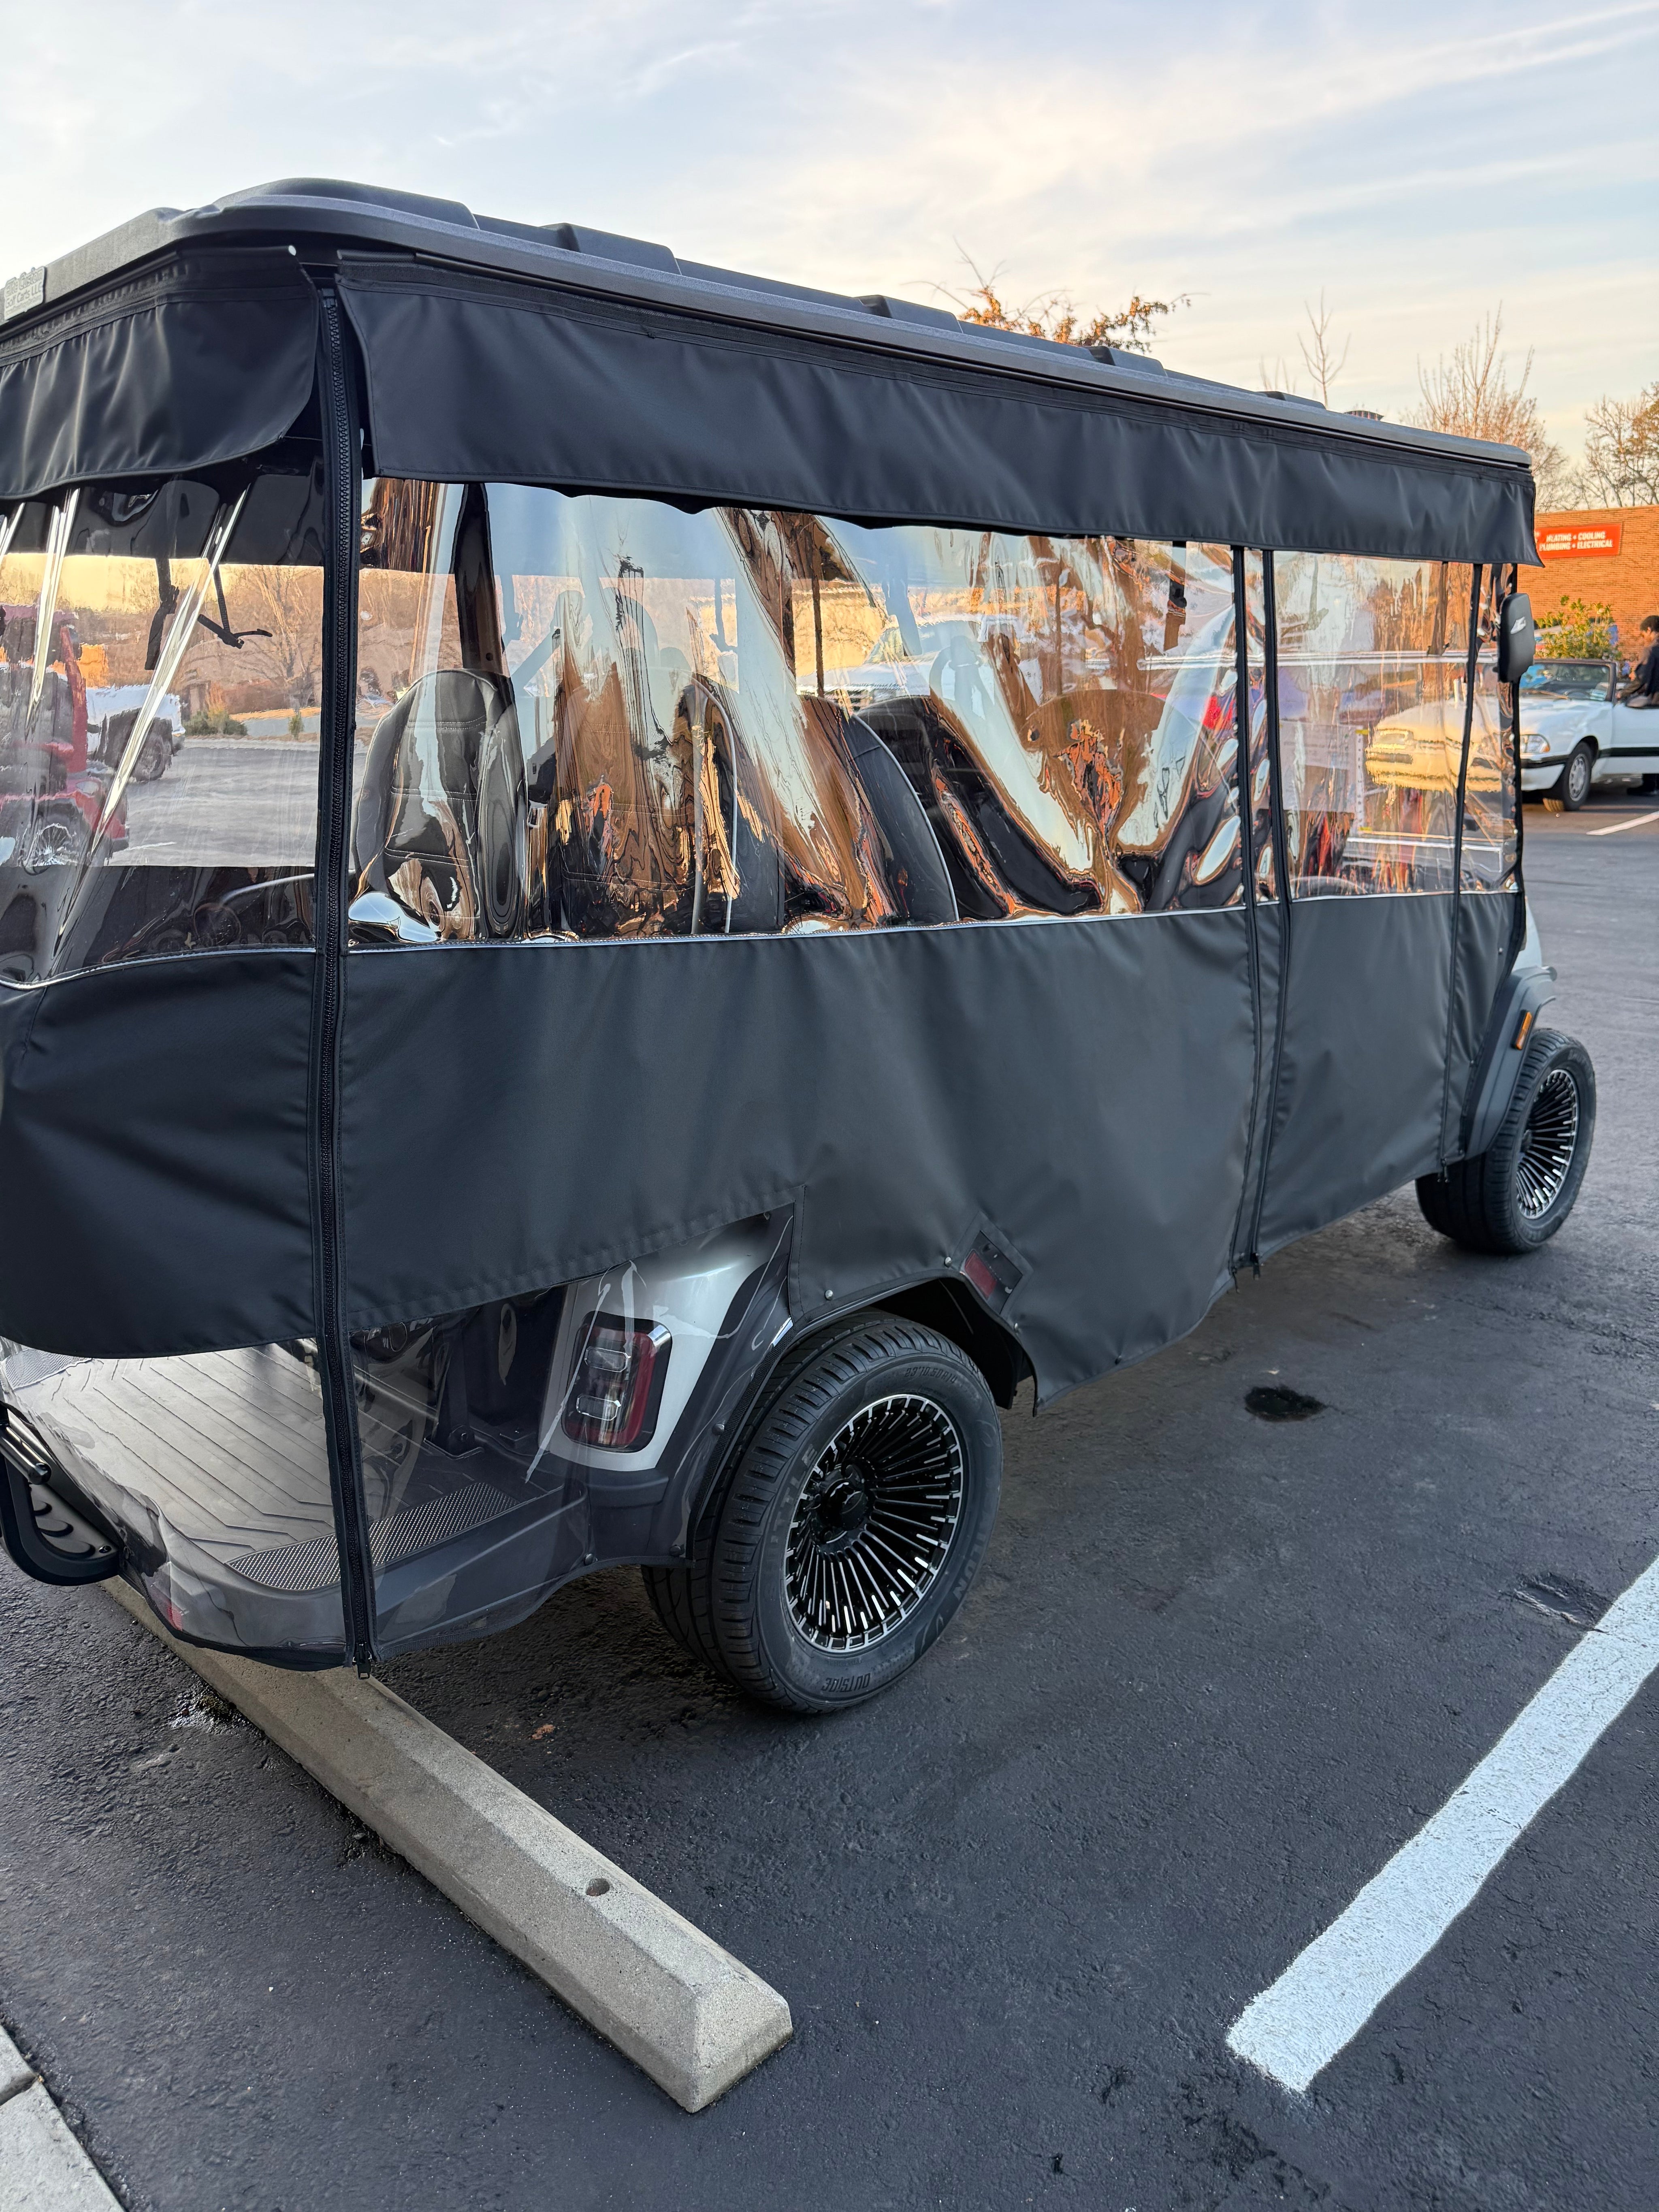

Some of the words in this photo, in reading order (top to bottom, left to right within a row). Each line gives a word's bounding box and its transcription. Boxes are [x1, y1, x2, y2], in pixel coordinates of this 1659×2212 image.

[6, 295, 16, 309] Golf
[17, 289, 30, 303] Carts
[32, 282, 41, 296] LLC
[1546, 533, 1572, 542] HEATING
[1578, 531, 1606, 541] COOLING
[1539, 542, 1572, 551] PLUMBING
[1577, 540, 1613, 549] ELECTRICAL
